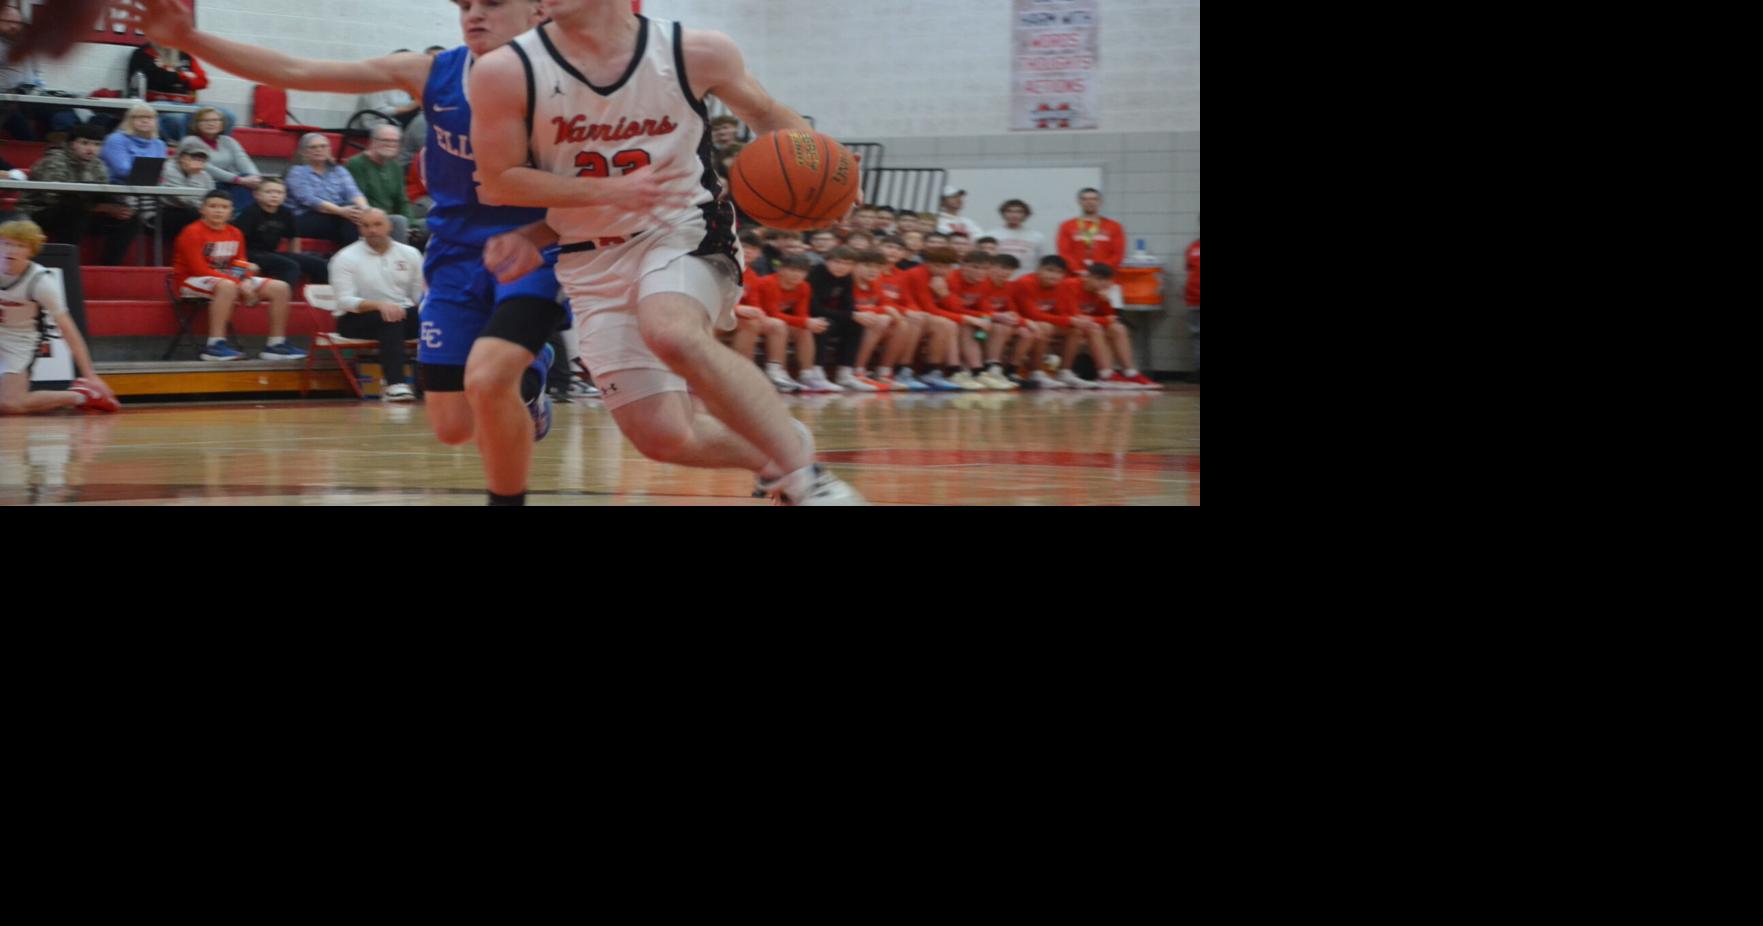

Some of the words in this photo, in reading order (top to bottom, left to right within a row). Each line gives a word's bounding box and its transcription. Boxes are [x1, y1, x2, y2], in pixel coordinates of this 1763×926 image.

[1027, 33, 1080, 48] WORDS
[1021, 55, 1092, 71] THOUGHTS
[1023, 78, 1086, 93] ACTIONS
[551, 114, 678, 145] Warriors
[432, 124, 474, 160] ELL
[421, 321, 443, 348] EC
